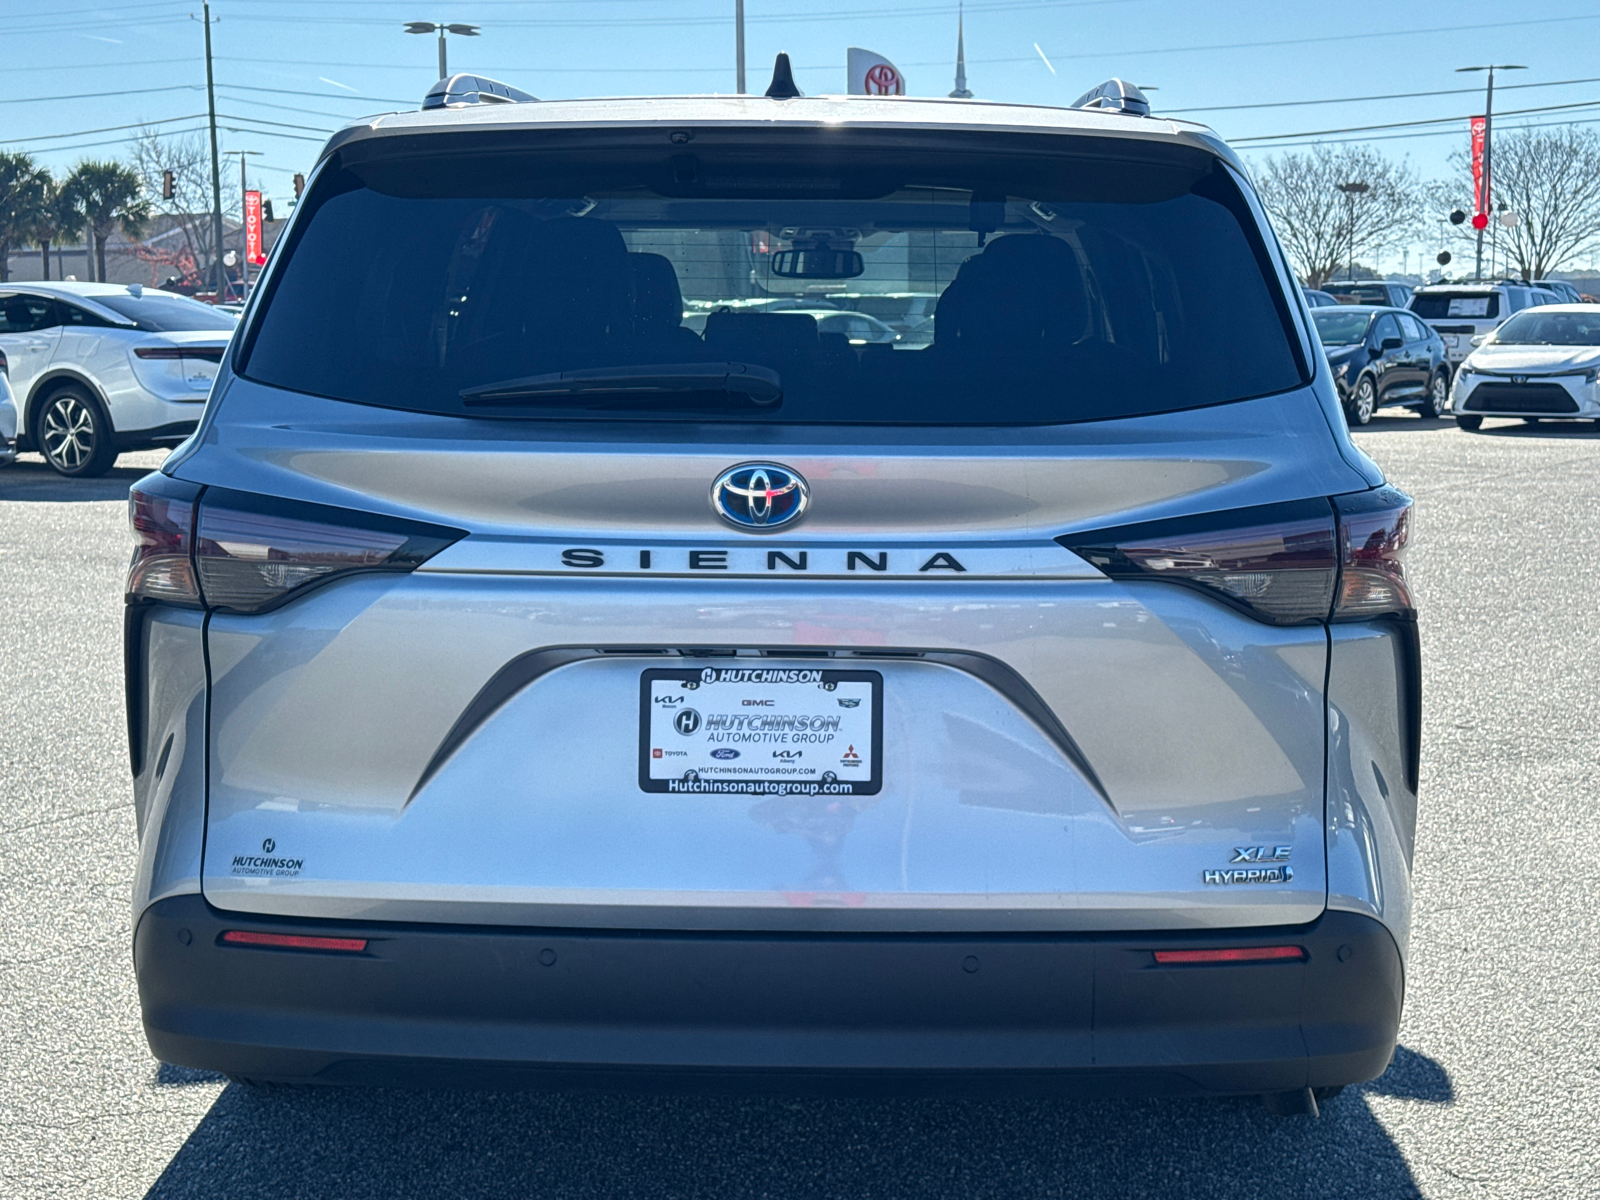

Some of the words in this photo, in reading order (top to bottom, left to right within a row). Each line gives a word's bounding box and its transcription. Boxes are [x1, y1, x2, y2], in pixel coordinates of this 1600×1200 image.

[247, 206, 257, 260] TOYOTA
[561, 548, 967, 572] SIENNA
[720, 669, 822, 683] HUTCHINSON
[705, 714, 841, 732] HUTCHINSON
[707, 732, 788, 743] AUTOMOTIVE
[792, 733, 834, 744] GROUP
[715, 749, 734, 759] Ford
[698, 766, 816, 775] HUTCHINSONAUTOGROUP.COM
[668, 779, 853, 795] Hutchinsonautogroup.com
[1229, 845, 1292, 863] XLE
[232, 856, 303, 870] HUTCHINSON
[232, 867, 274, 875] AUTOMOTIVE
[1203, 869, 1279, 884] HYBRID
